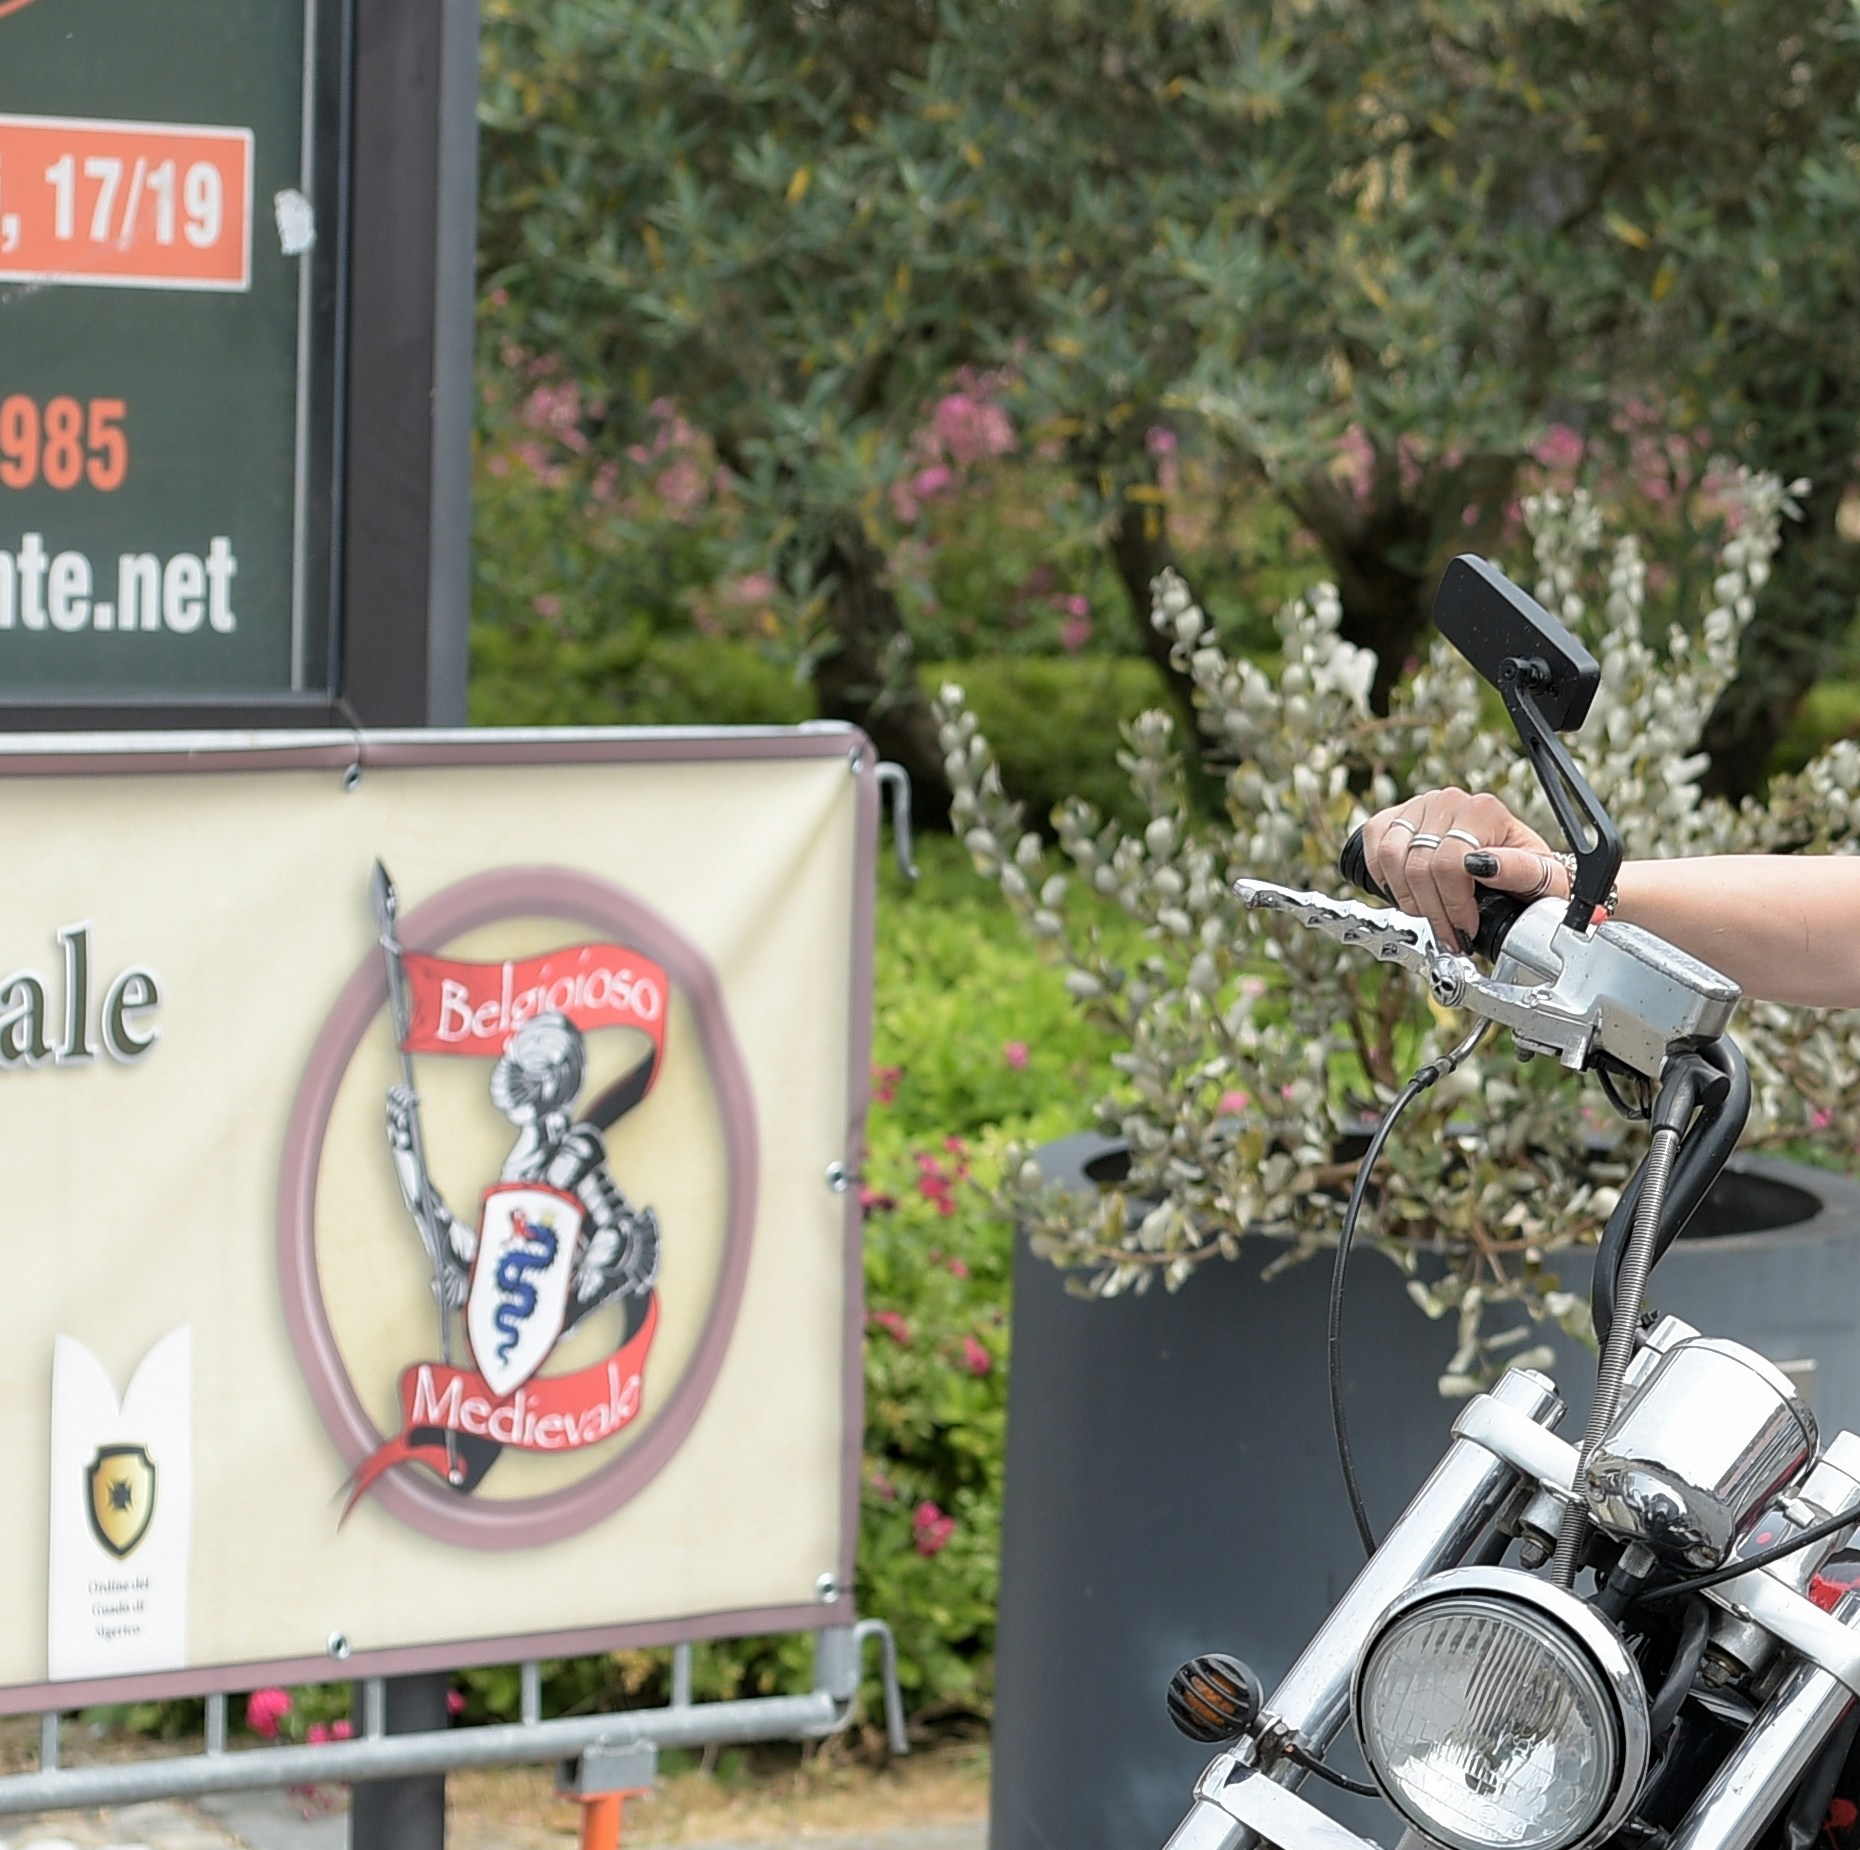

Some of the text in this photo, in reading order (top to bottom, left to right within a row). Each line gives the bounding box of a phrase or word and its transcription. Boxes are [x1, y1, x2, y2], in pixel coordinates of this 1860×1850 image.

[45, 154, 223, 250] 17/19
[0, 394, 129, 491] 985
[0, 920, 164, 1068] ale
[434, 946, 662, 1052] Belgioioso
[411, 1359, 641, 1449] Medievale
